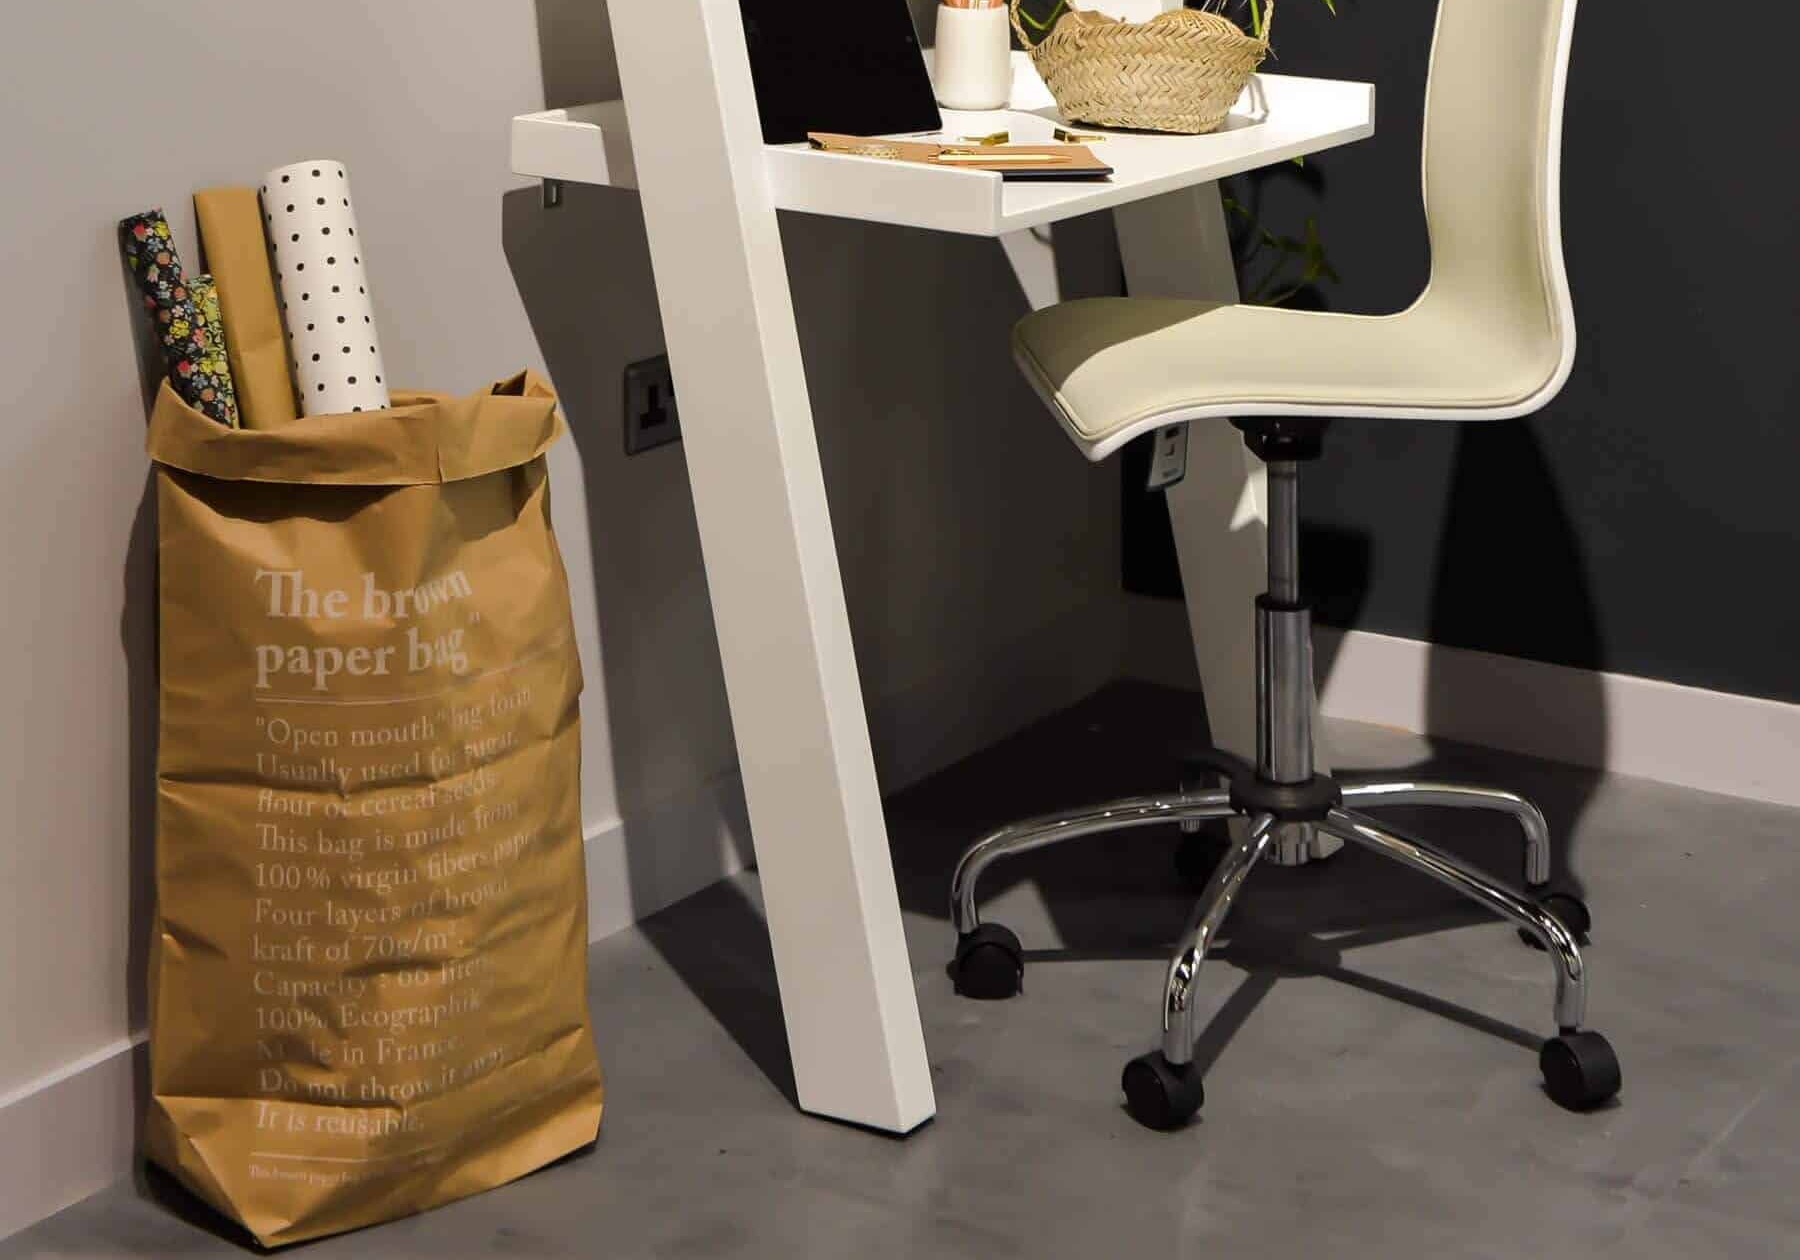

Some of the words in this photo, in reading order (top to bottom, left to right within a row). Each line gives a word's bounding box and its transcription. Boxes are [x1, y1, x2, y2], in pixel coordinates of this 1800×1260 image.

[255, 568, 349, 619] The
[361, 569, 473, 621] brown
[255, 644, 396, 691] paper
[407, 627, 470, 677] bag
[256, 753, 352, 791] Usually
[361, 752, 420, 779] used
[256, 822, 307, 852] This
[317, 830, 364, 861] bag
[375, 827, 395, 852] is
[255, 897, 321, 926] Four
[327, 900, 401, 933] layers
[253, 934, 316, 962] kraft
[325, 935, 351, 961] of
[342, 1041, 365, 1066] in
